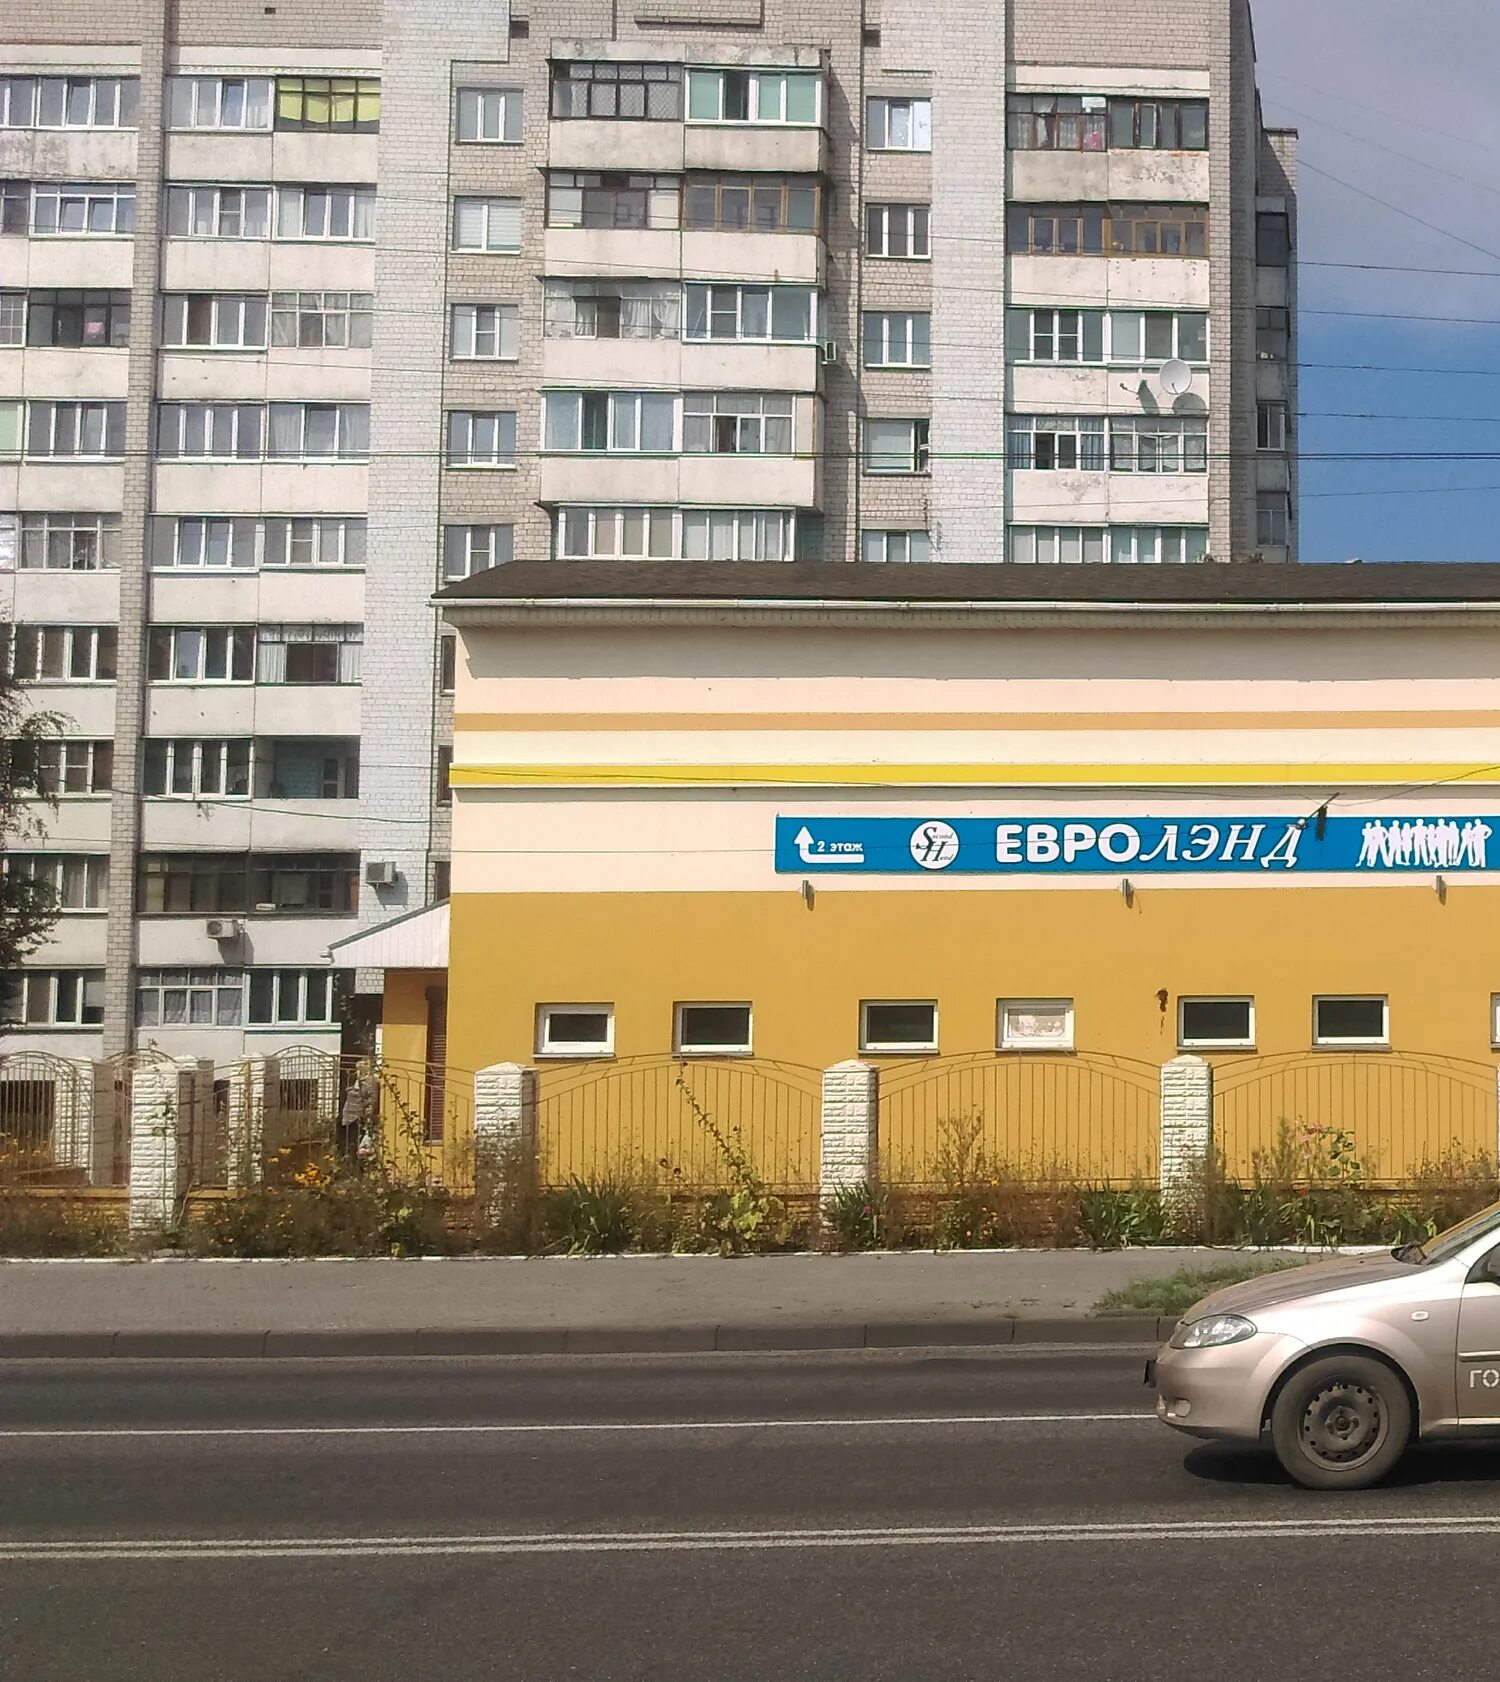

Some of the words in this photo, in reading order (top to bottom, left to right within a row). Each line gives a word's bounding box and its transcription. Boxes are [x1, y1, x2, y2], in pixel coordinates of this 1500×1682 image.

[817, 841, 825, 852] 2
[829, 842, 864, 852] этаж
[995, 823, 1304, 868] ЕВРОЛЭНД
